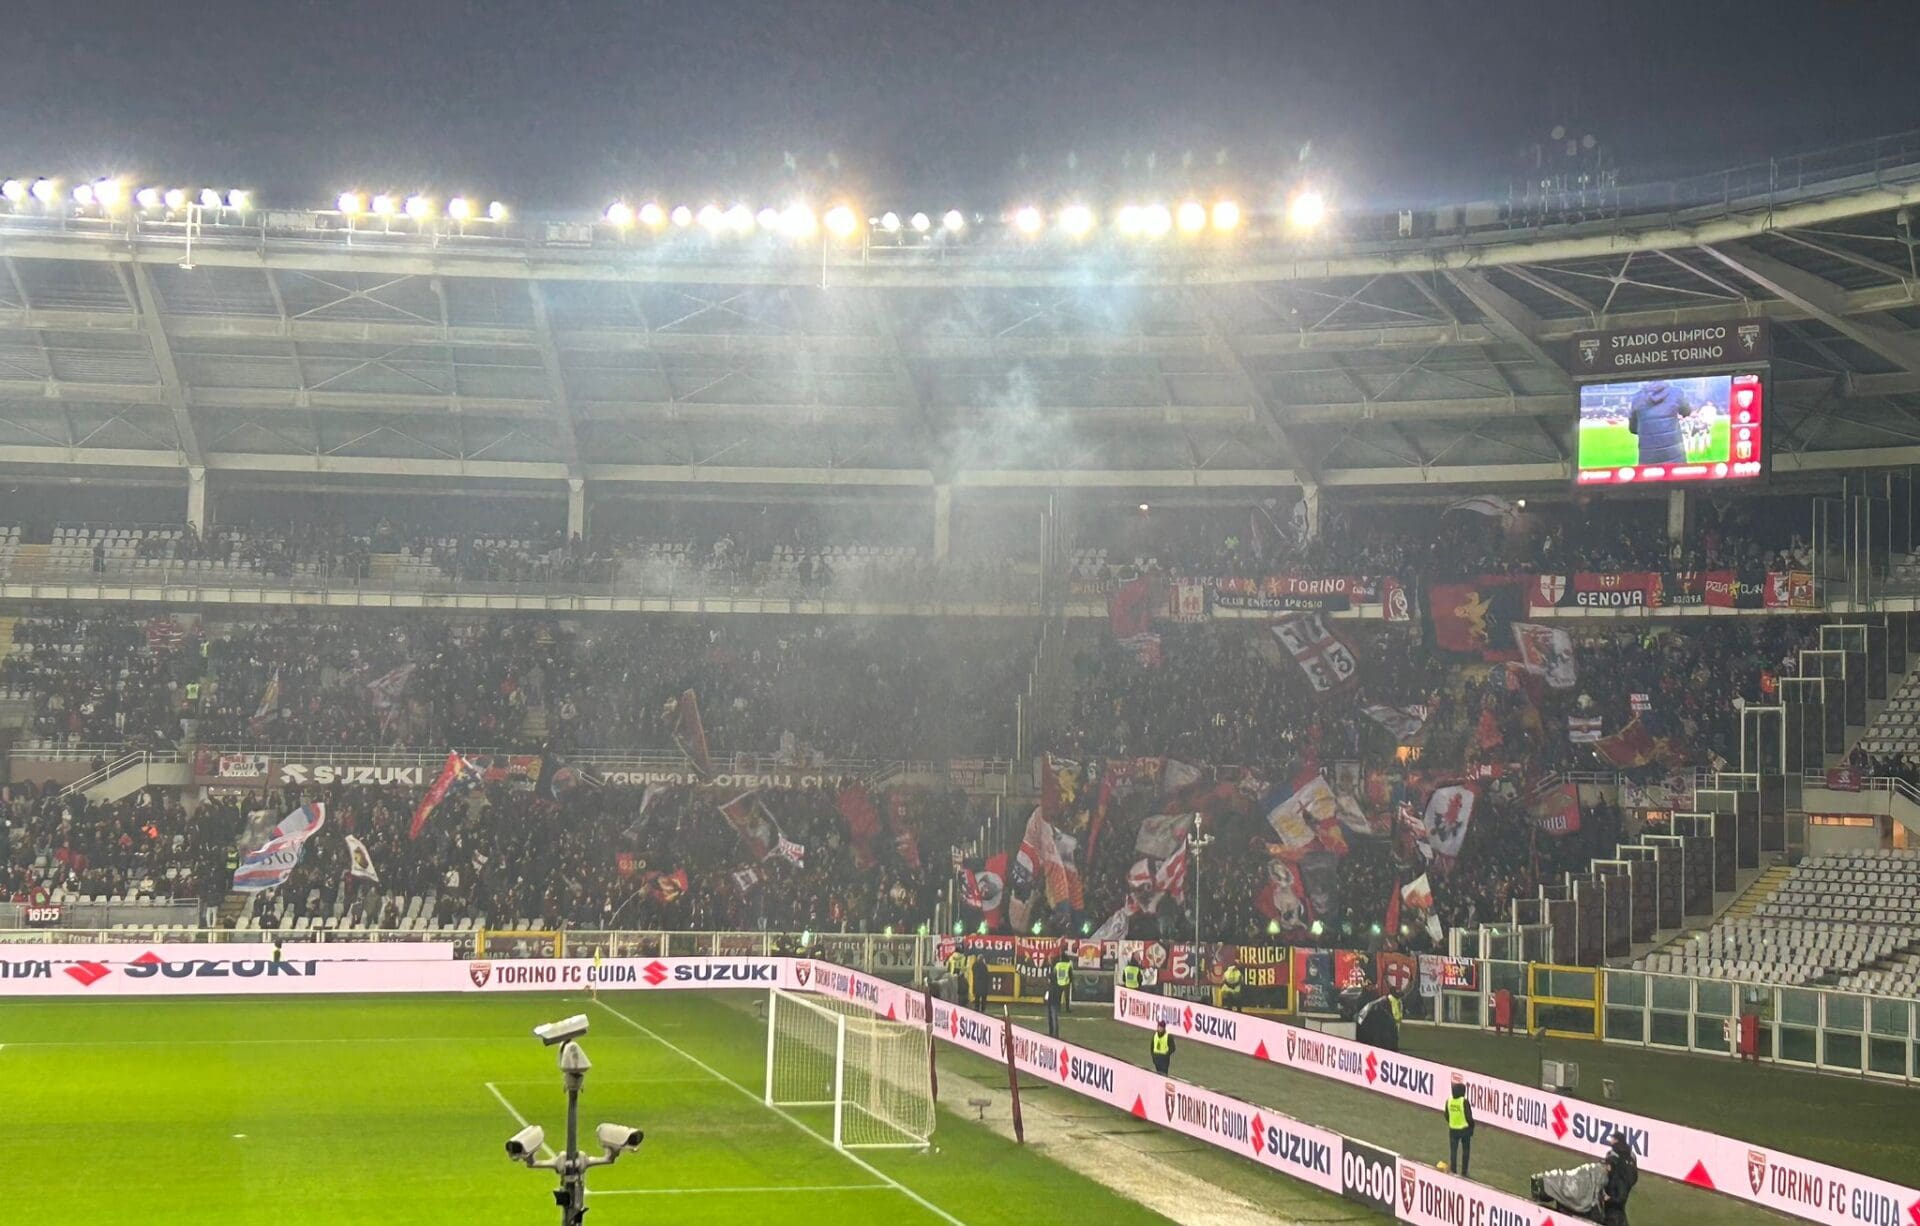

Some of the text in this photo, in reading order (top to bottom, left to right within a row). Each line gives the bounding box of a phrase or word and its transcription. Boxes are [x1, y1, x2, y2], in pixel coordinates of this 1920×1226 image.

[1611, 332, 1659, 349] STADIO
[1662, 327, 1726, 344] OLIMPICO
[1614, 345, 1723, 366] GRANDE TORINO
[1287, 578, 1346, 594] TORINO
[1576, 589, 1643, 607] GENOVA
[314, 766, 422, 785] SUZUKI
[27, 907, 60, 921] 16155
[495, 964, 778, 984] TORINO FC GUIDA SUZUKI
[1244, 967, 1276, 986] 1988
[959, 1015, 991, 1047] SUZUKI
[1151, 1003, 1161, 1023] FC
[1194, 1013, 1237, 1041] SUZUKI
[1029, 1040, 1039, 1066] FC
[1038, 1043, 1058, 1073] GUIDA
[1071, 1056, 1114, 1093] SUZUKI
[1298, 1038, 1434, 1096] TORINO FC GUIDA SUZUKI
[1465, 1081, 1500, 1118] TORINO
[1502, 1091, 1514, 1119] FC
[1516, 1096, 1548, 1130] GUIDA
[1177, 1092, 1331, 1175] TORINO FC GUIDA SUZUKI
[1343, 1151, 1395, 1205] 00:00
[1418, 1179, 1465, 1226] TORINO
[1469, 1198, 1485, 1226] FC
[1770, 1163, 1900, 1226] TORINO FC GUIDA
